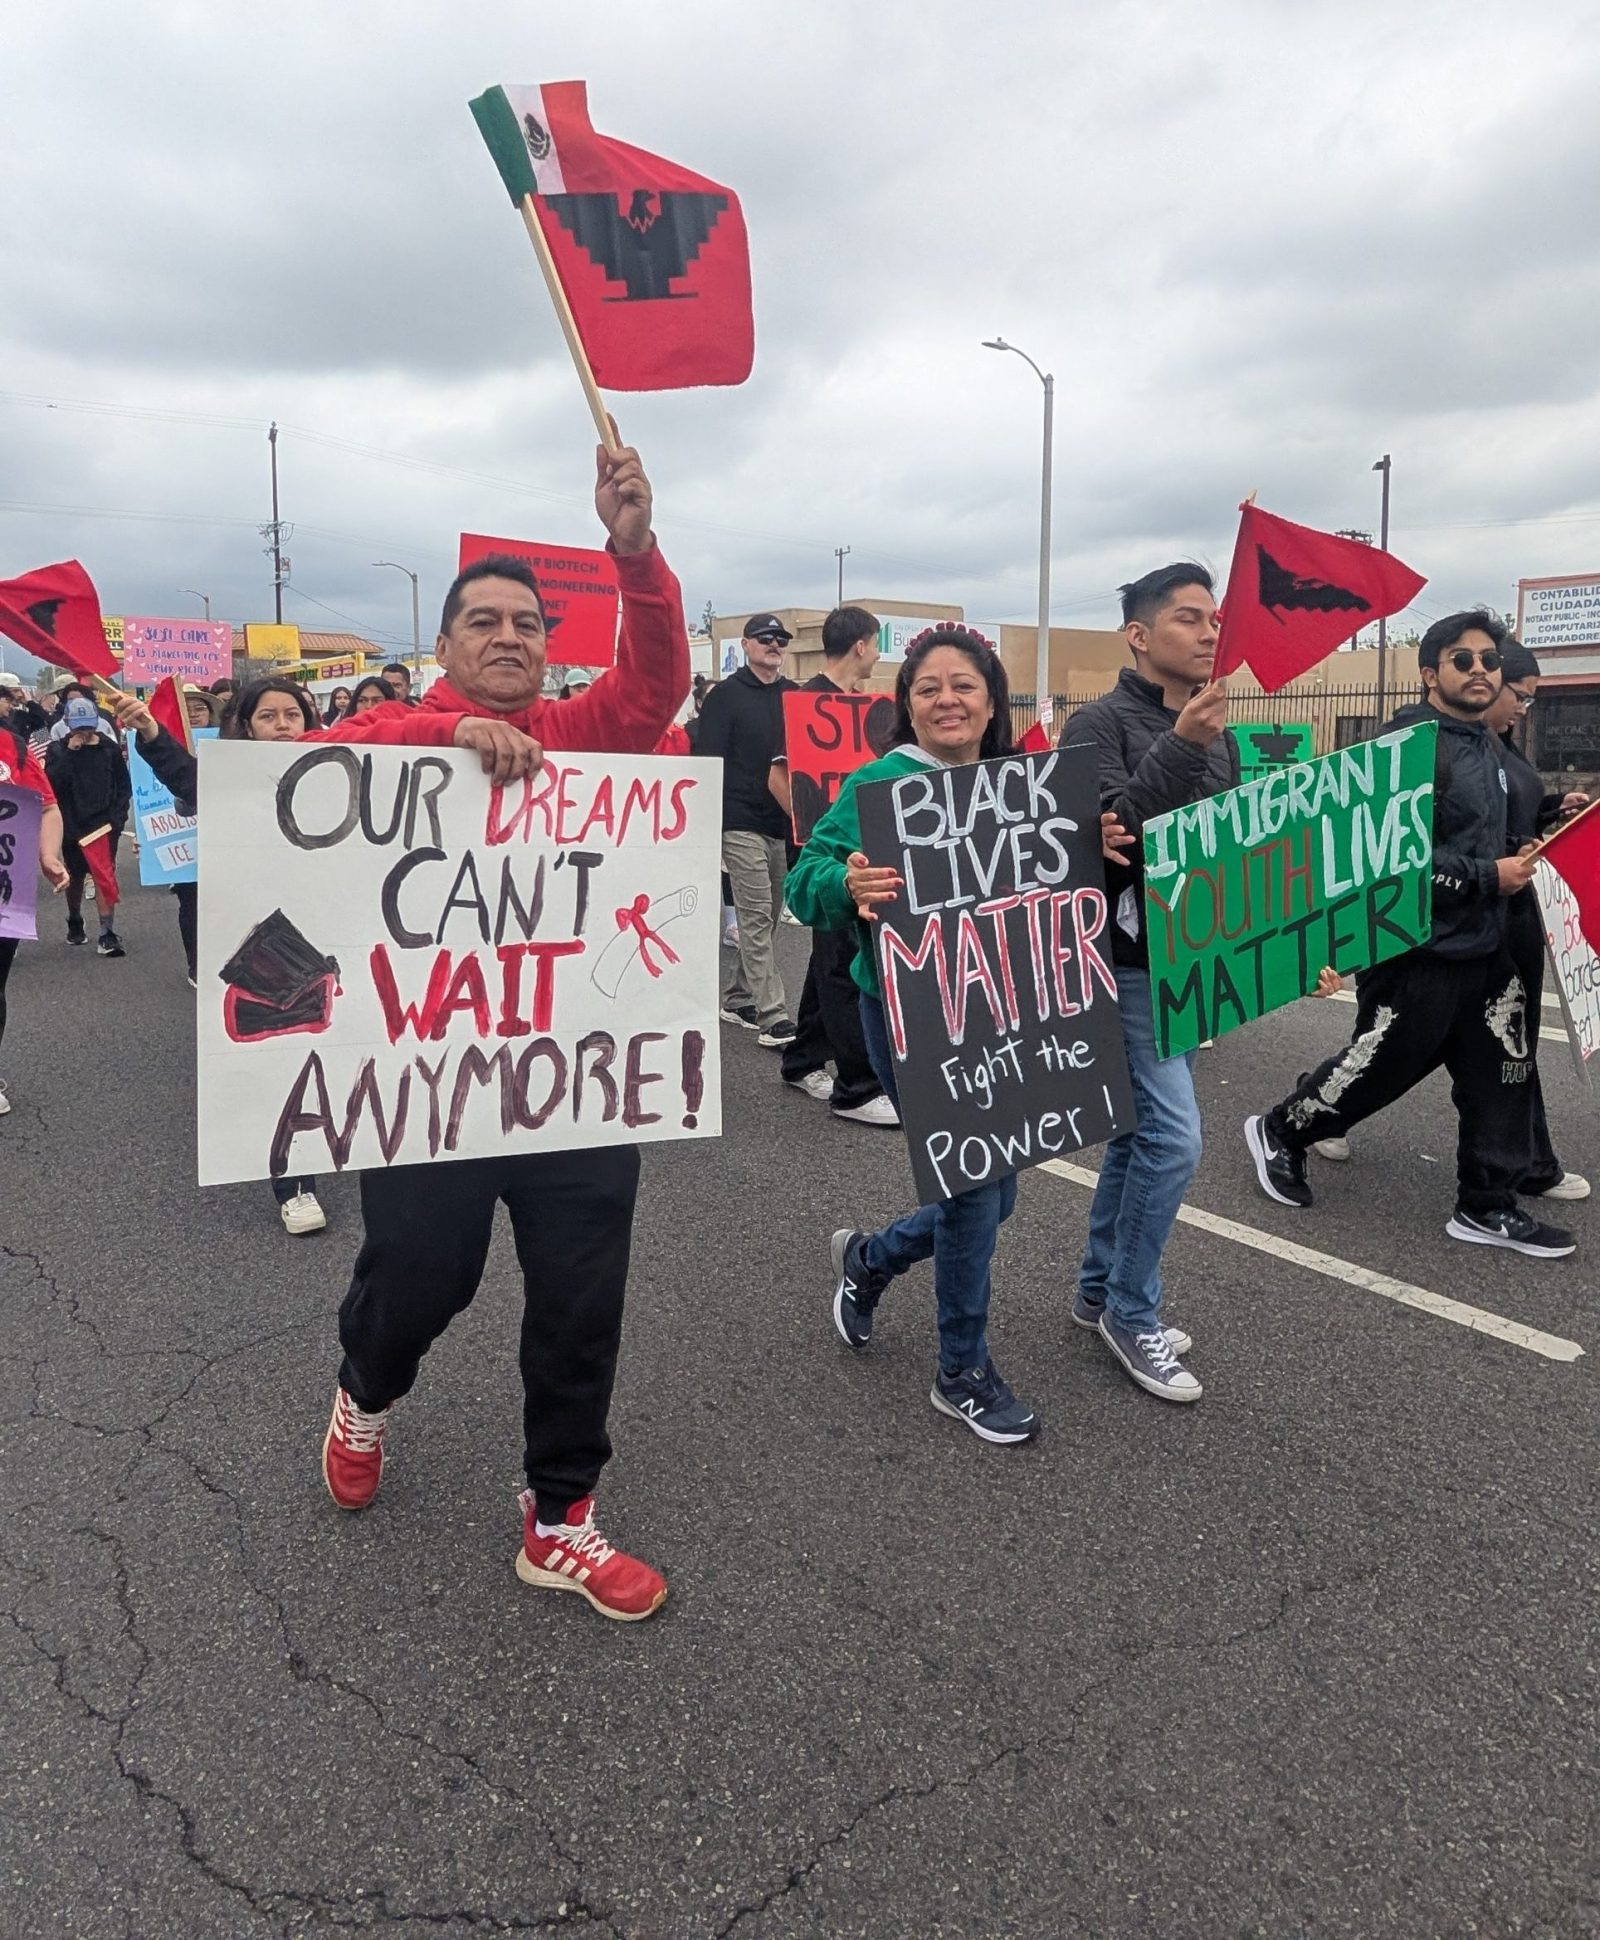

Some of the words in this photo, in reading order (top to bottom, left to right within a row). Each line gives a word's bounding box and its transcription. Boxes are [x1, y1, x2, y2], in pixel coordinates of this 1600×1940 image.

[538, 578, 616, 595] NGINEERING
[543, 599, 568, 610] NET
[544, 558, 599, 574] BIOTECH
[1525, 614, 1552, 623] NOTARY
[276, 746, 453, 850] OUR
[485, 758, 698, 847] DREAMS
[892, 752, 1060, 845] BLACK
[1145, 729, 1415, 879] IMMIGRANT
[168, 843, 194, 866] ICE
[381, 847, 603, 949] CAN'T
[904, 818, 1078, 915] LIVES
[1147, 827, 1313, 965] YOUTH
[1322, 783, 1434, 898] LIVES
[1431, 873, 1462, 890] PLY
[370, 940, 586, 1045] WAIT
[879, 887, 1118, 1062] MATTER
[1158, 871, 1430, 1059] MATTER!
[269, 1030, 706, 1177] ANYMORE!
[940, 1037, 1024, 1110] Fight
[1036, 1035, 1095, 1073] the
